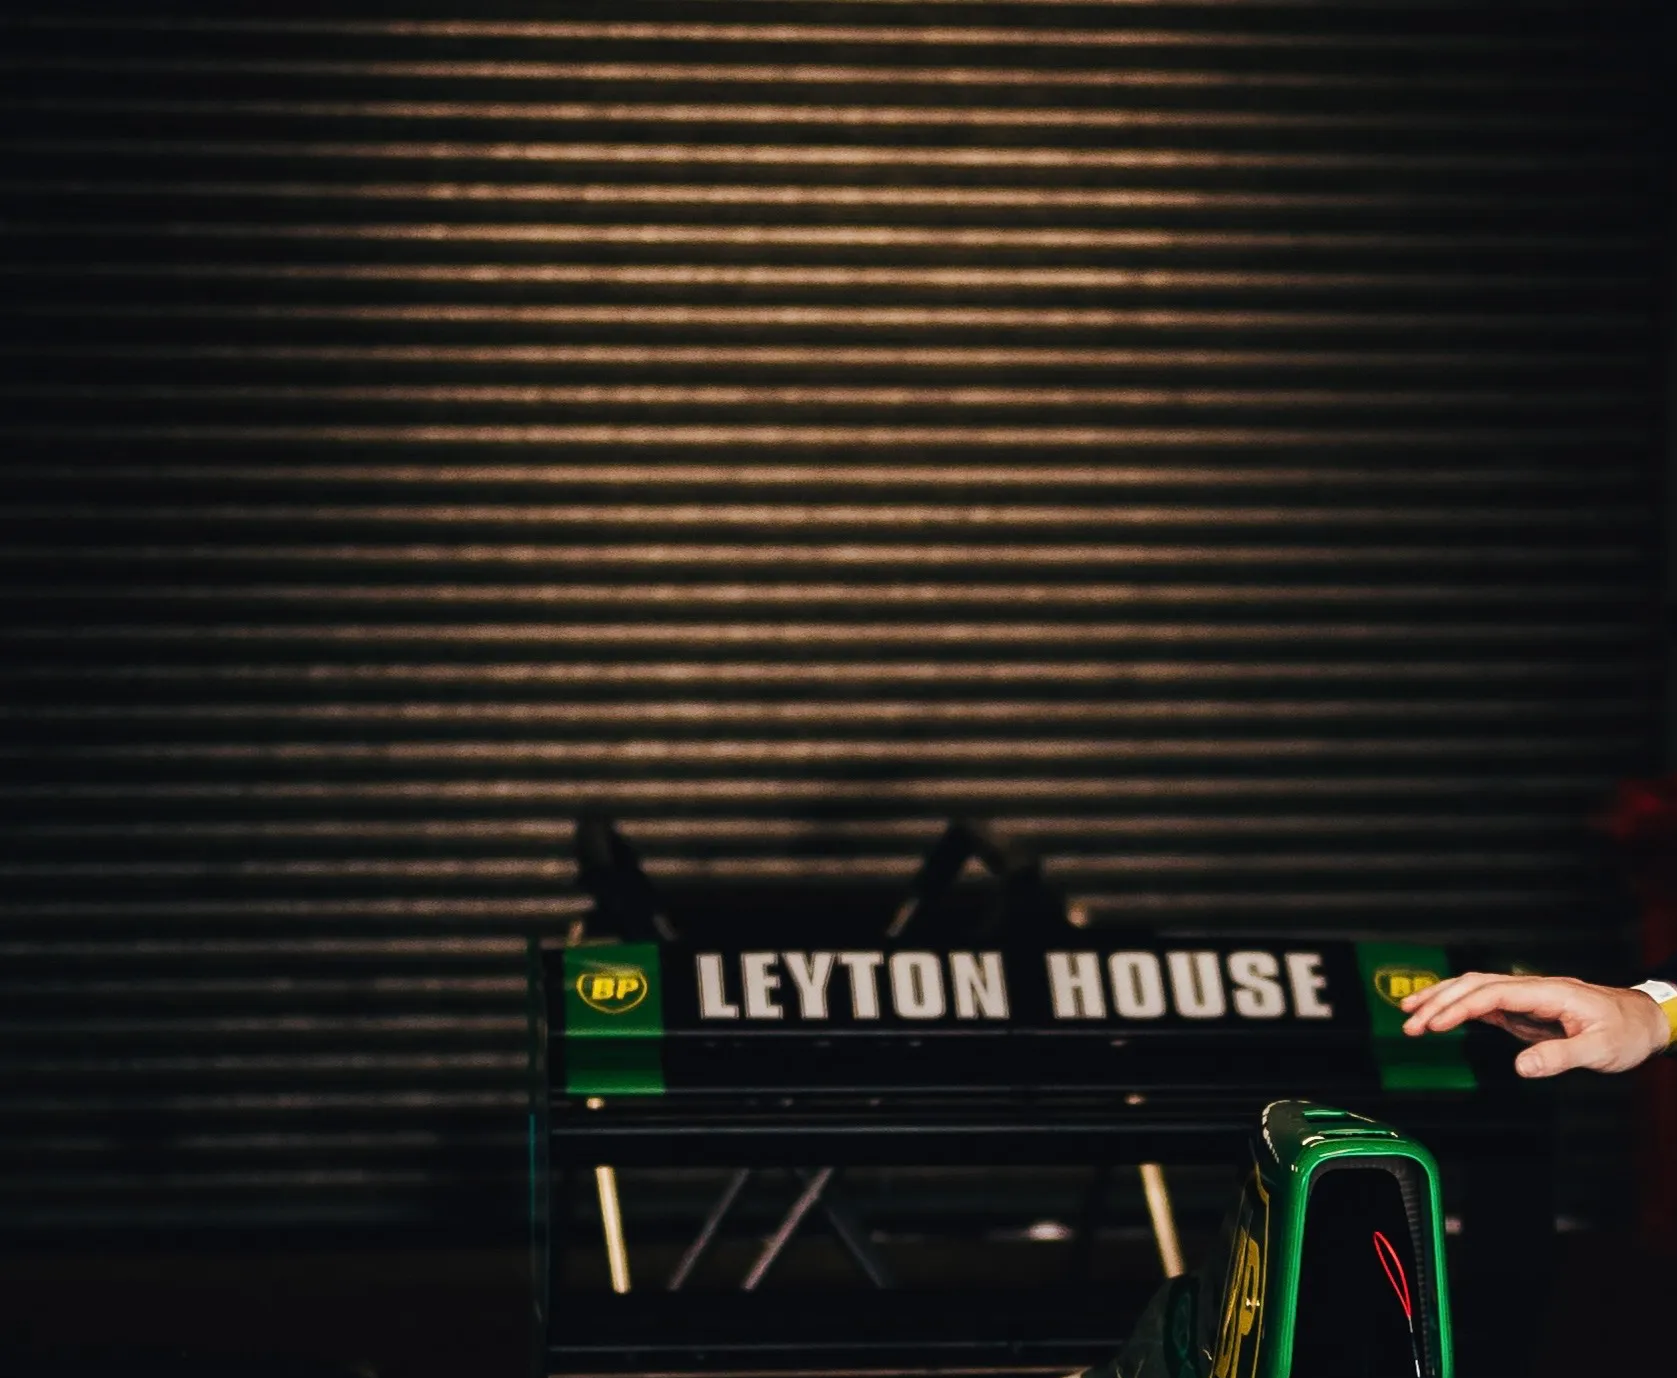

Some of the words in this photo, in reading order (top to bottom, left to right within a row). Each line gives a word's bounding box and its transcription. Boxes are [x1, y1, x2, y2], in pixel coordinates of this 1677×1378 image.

[592, 977, 639, 1000] BP
[696, 952, 1010, 1020] LEYTON
[1046, 951, 1333, 1019] HOUSE
